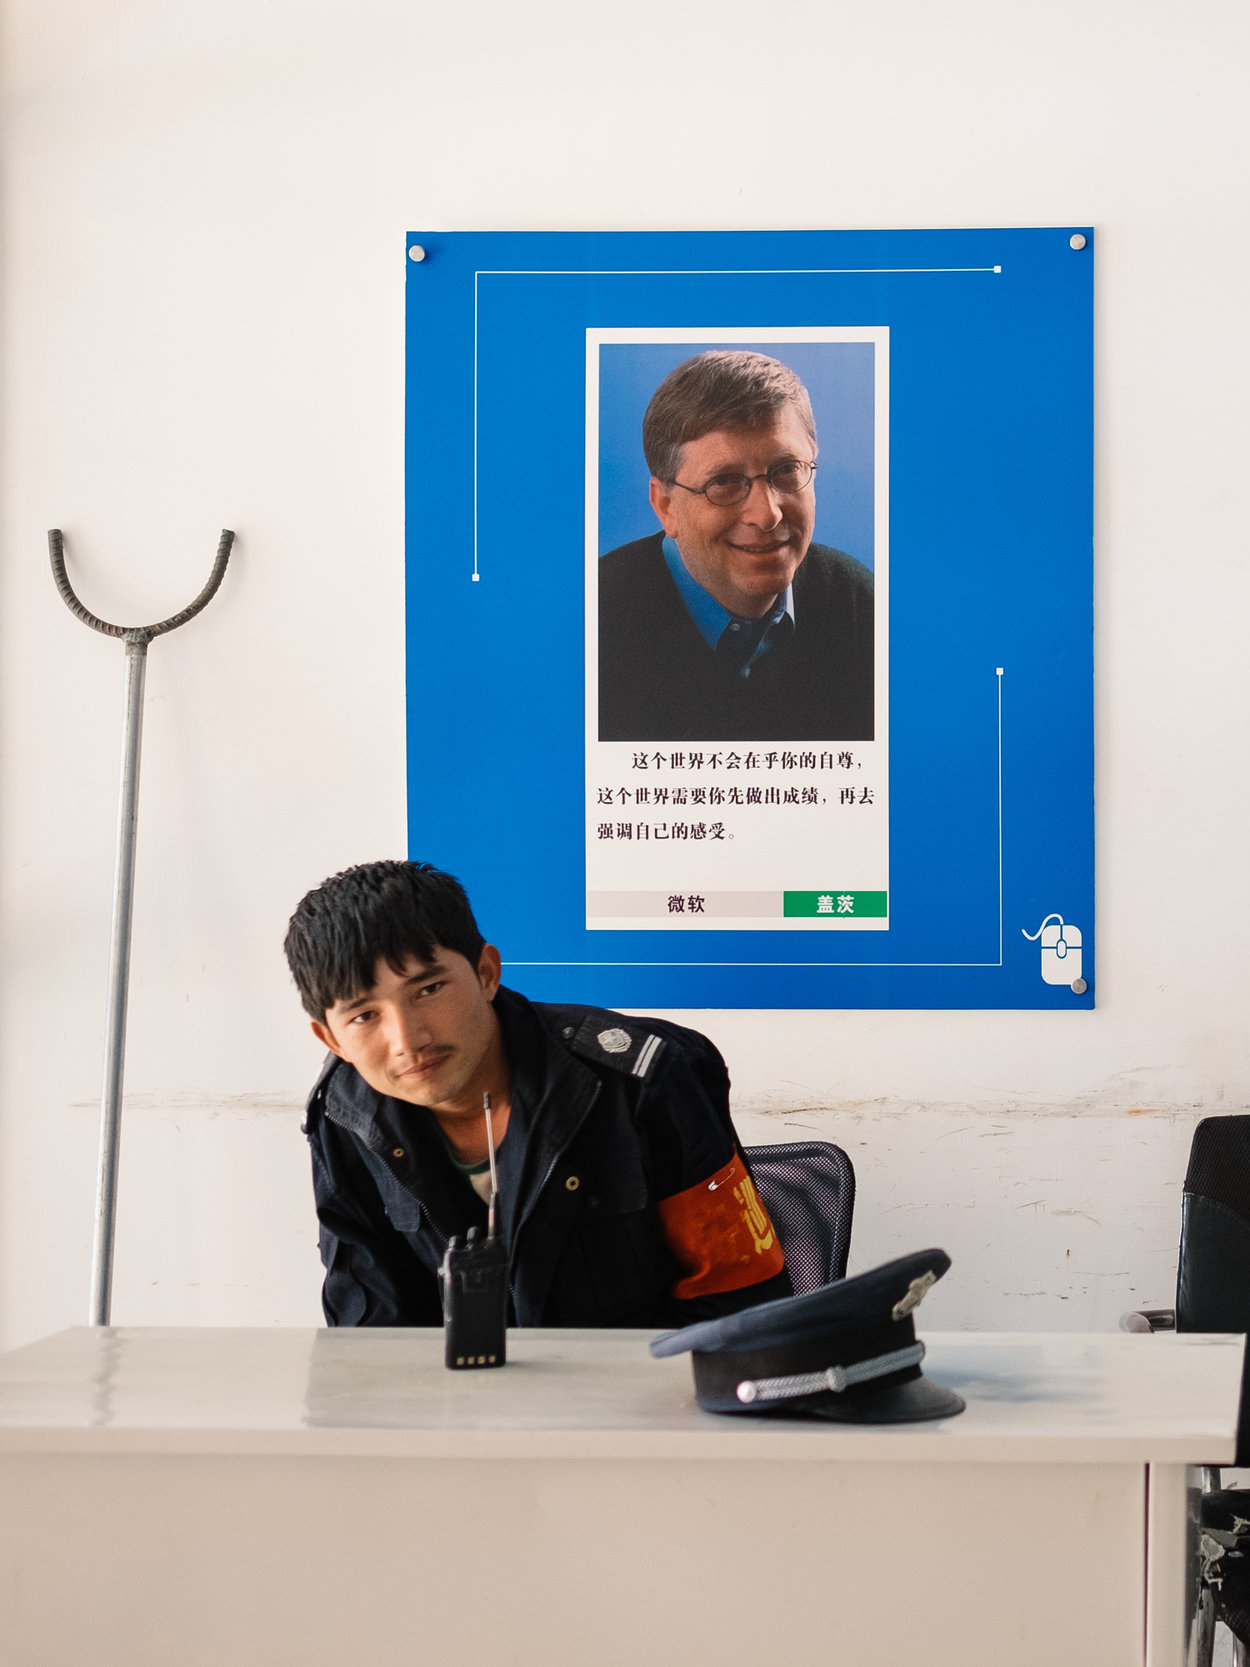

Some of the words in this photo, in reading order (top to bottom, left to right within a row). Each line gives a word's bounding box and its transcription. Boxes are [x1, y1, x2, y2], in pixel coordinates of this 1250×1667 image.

[631, 752, 863, 770] 这个世界不会在乎你的自尊，
[597, 822, 735, 840] 强调自己的感受。
[668, 894, 706, 913] 微软
[816, 894, 855, 913] 盖茨
